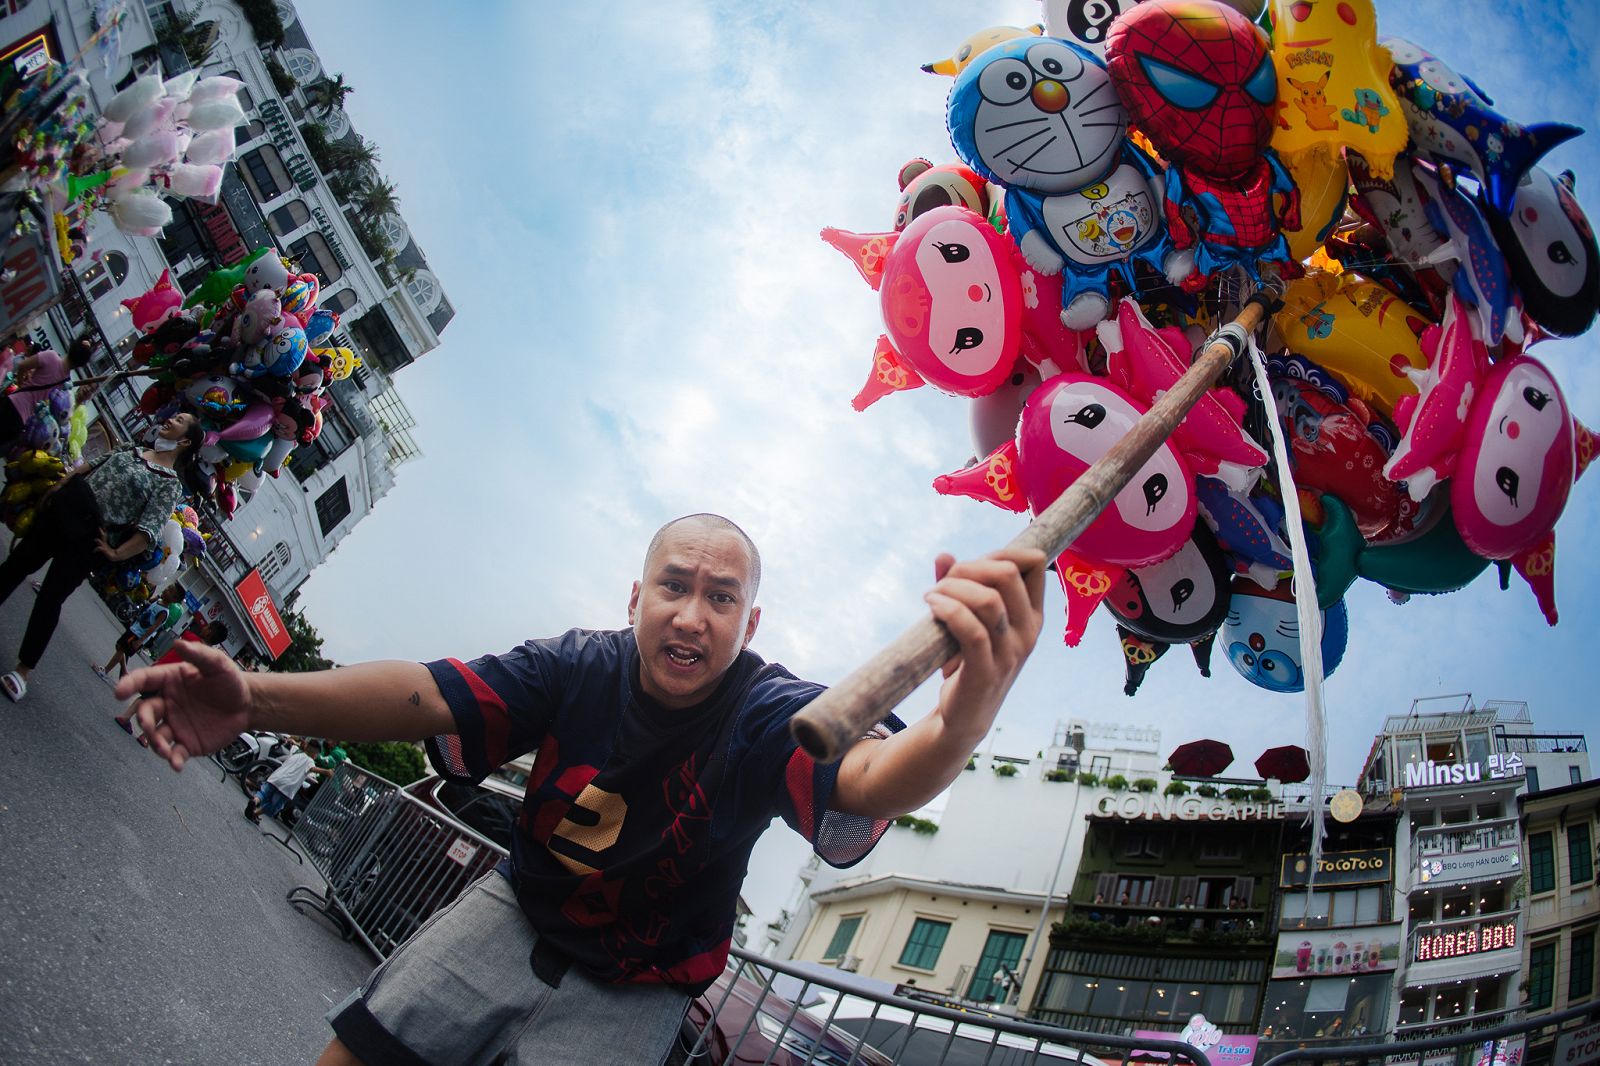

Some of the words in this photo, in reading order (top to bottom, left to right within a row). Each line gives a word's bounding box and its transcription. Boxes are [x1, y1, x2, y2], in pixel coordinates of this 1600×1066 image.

[259, 99, 297, 152] COFFEE
[286, 154, 317, 193] CLUB
[321, 225, 331, 234] &
[325, 232, 353, 271] Restaurant
[1405, 759, 1481, 788] Minsu
[1488, 751, 1523, 779] 민수
[1442, 862, 1457, 871] BBQ
[1420, 930, 1477, 960] KOREA
[1481, 923, 1515, 951] BBQ
